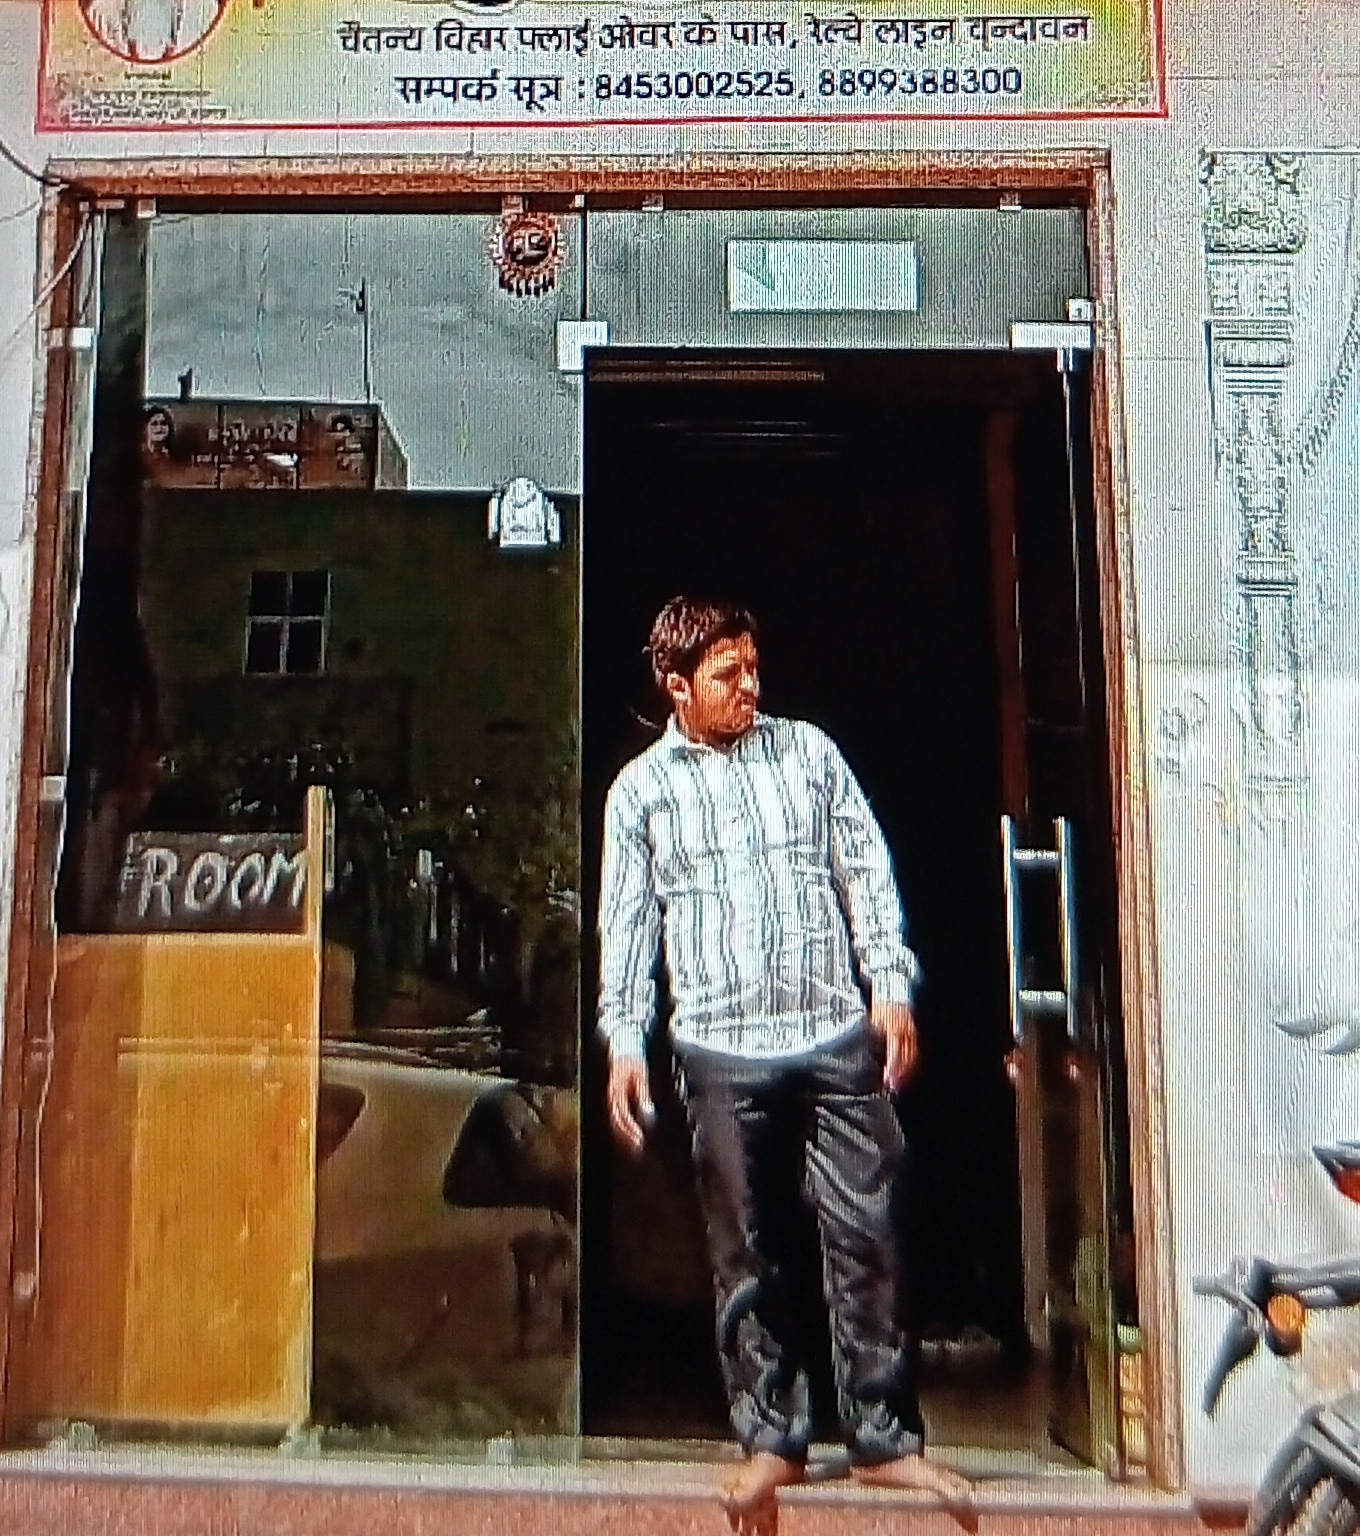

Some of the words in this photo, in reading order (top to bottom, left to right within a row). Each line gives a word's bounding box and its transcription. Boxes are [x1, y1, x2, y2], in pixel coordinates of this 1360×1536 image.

[434, 18, 508, 52] विहार
[598, 16, 676, 50] ओवर
[681, 16, 717, 47] के
[871, 18, 957, 50] लाइन
[394, 68, 501, 104] सम्पर्क
[506, 75, 563, 111] सूत्र
[135, 846, 309, 919] ROOM
